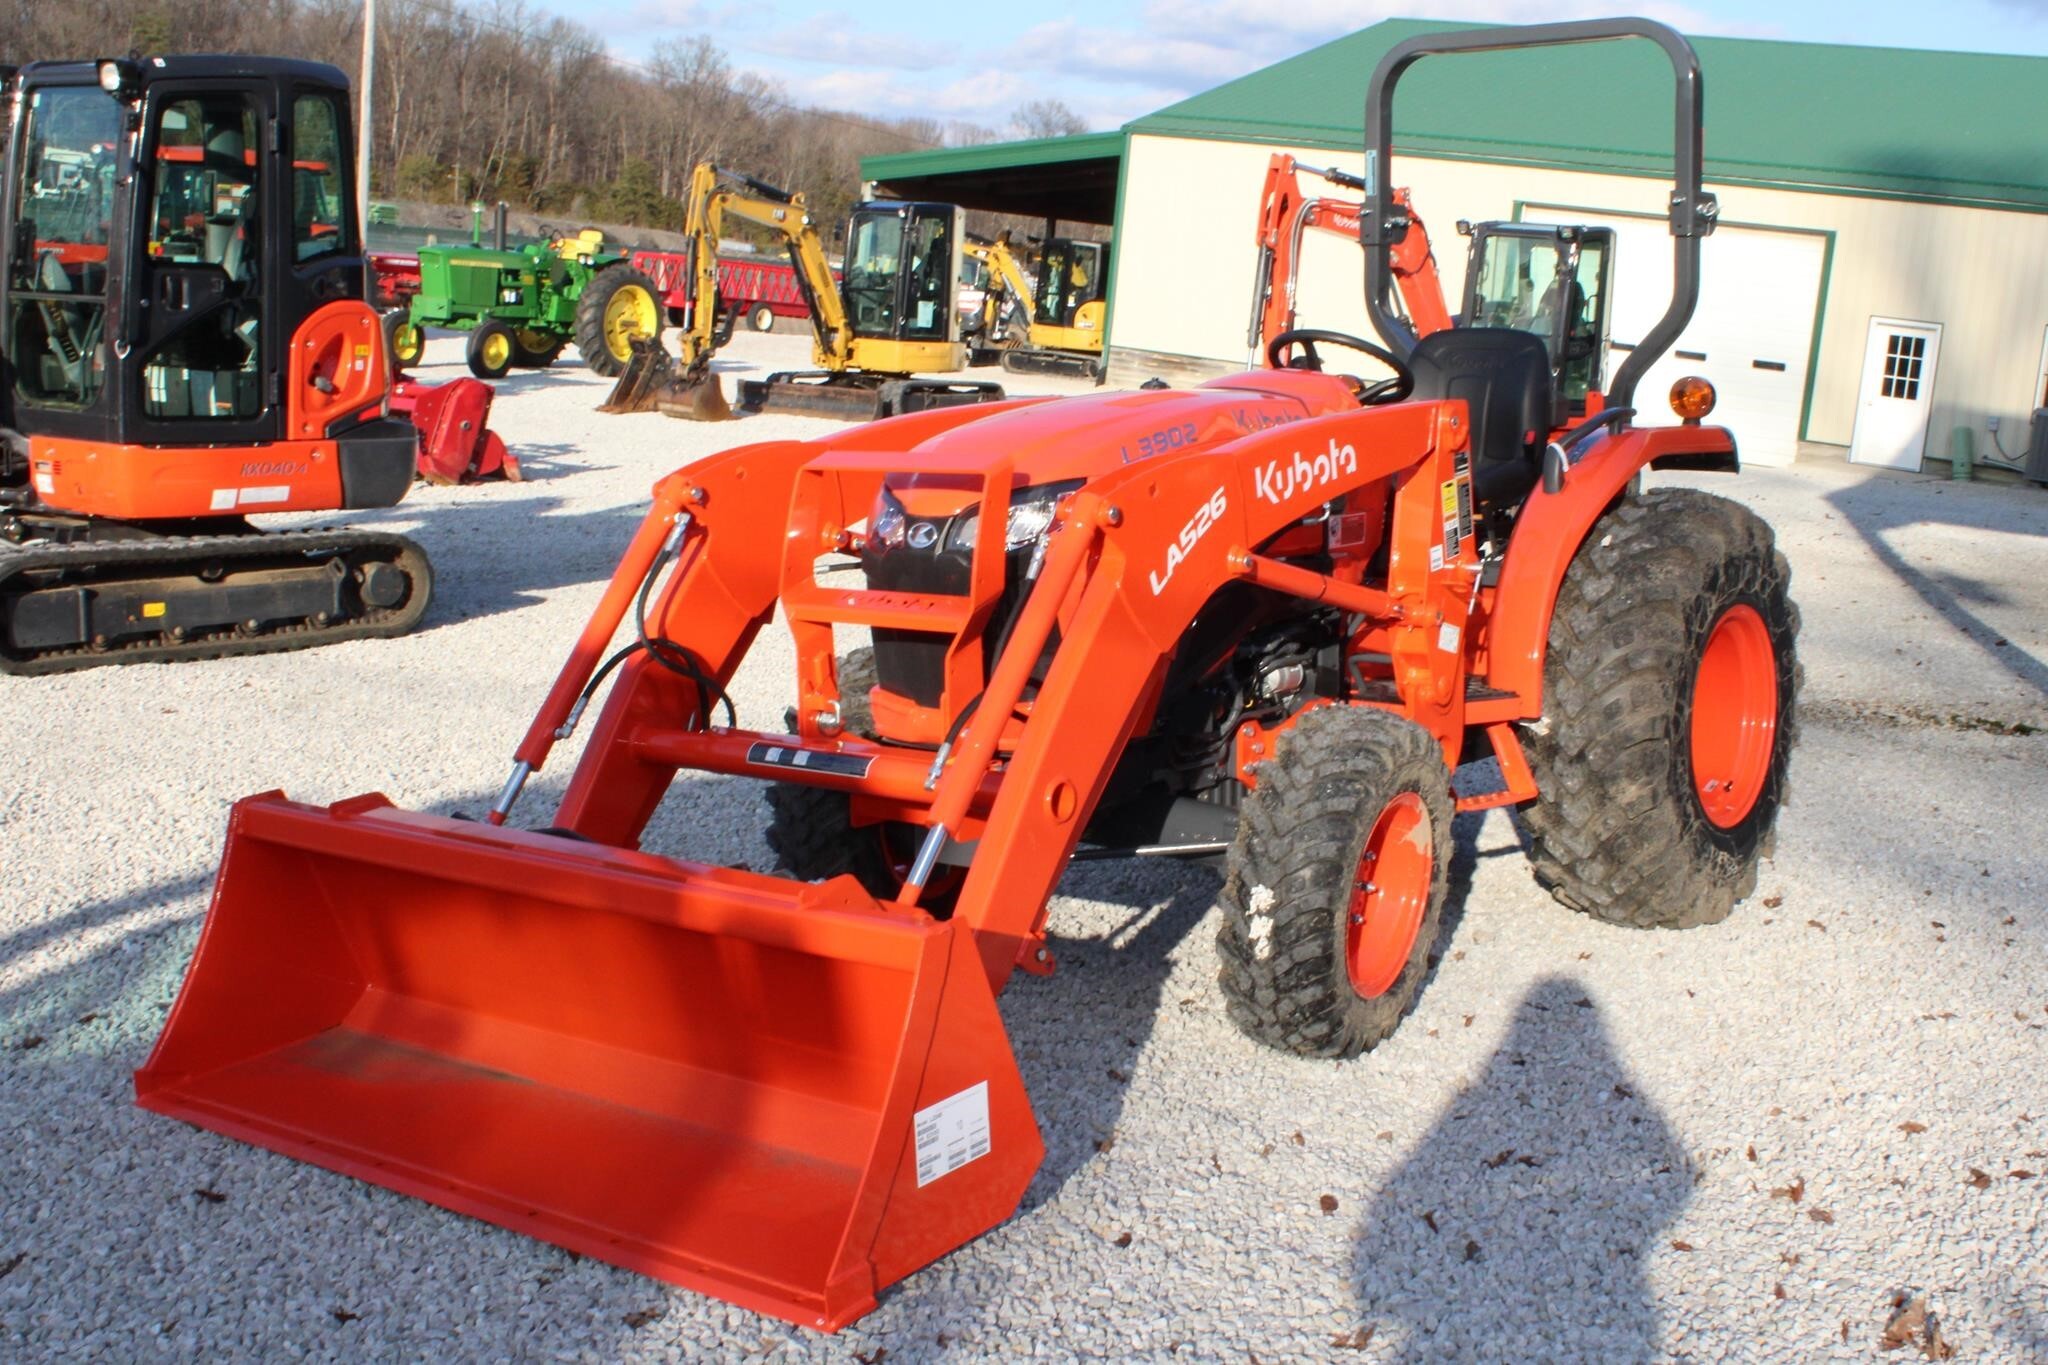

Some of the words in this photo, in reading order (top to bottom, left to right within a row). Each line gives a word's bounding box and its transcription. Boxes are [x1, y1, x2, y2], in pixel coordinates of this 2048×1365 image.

[1120, 423, 1198, 464] L3902
[1254, 438, 1357, 504] Kubota
[1149, 486, 1228, 596] LA526
